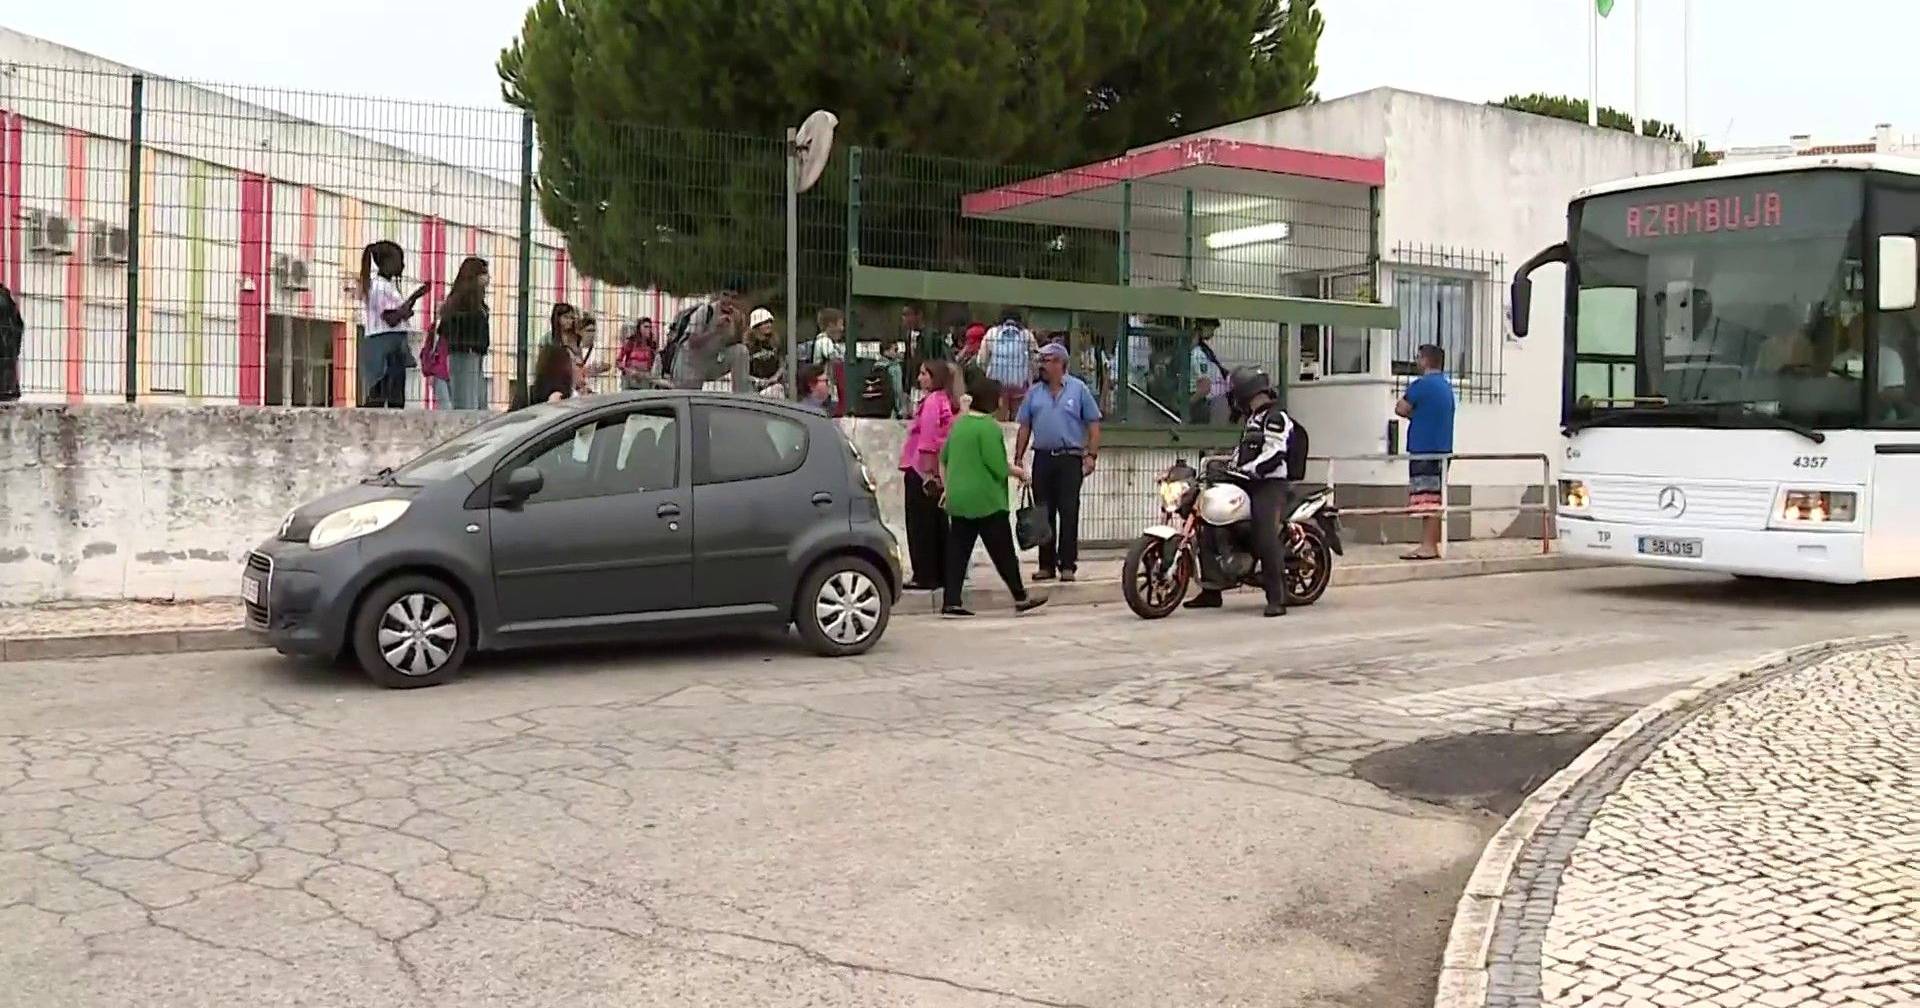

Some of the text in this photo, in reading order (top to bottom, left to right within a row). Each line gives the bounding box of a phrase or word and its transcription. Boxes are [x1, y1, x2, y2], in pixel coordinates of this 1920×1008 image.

[1626, 192, 1781, 238] AZAMBUJA
[1792, 456, 1828, 468] 4357
[1597, 530, 1611, 542] TP
